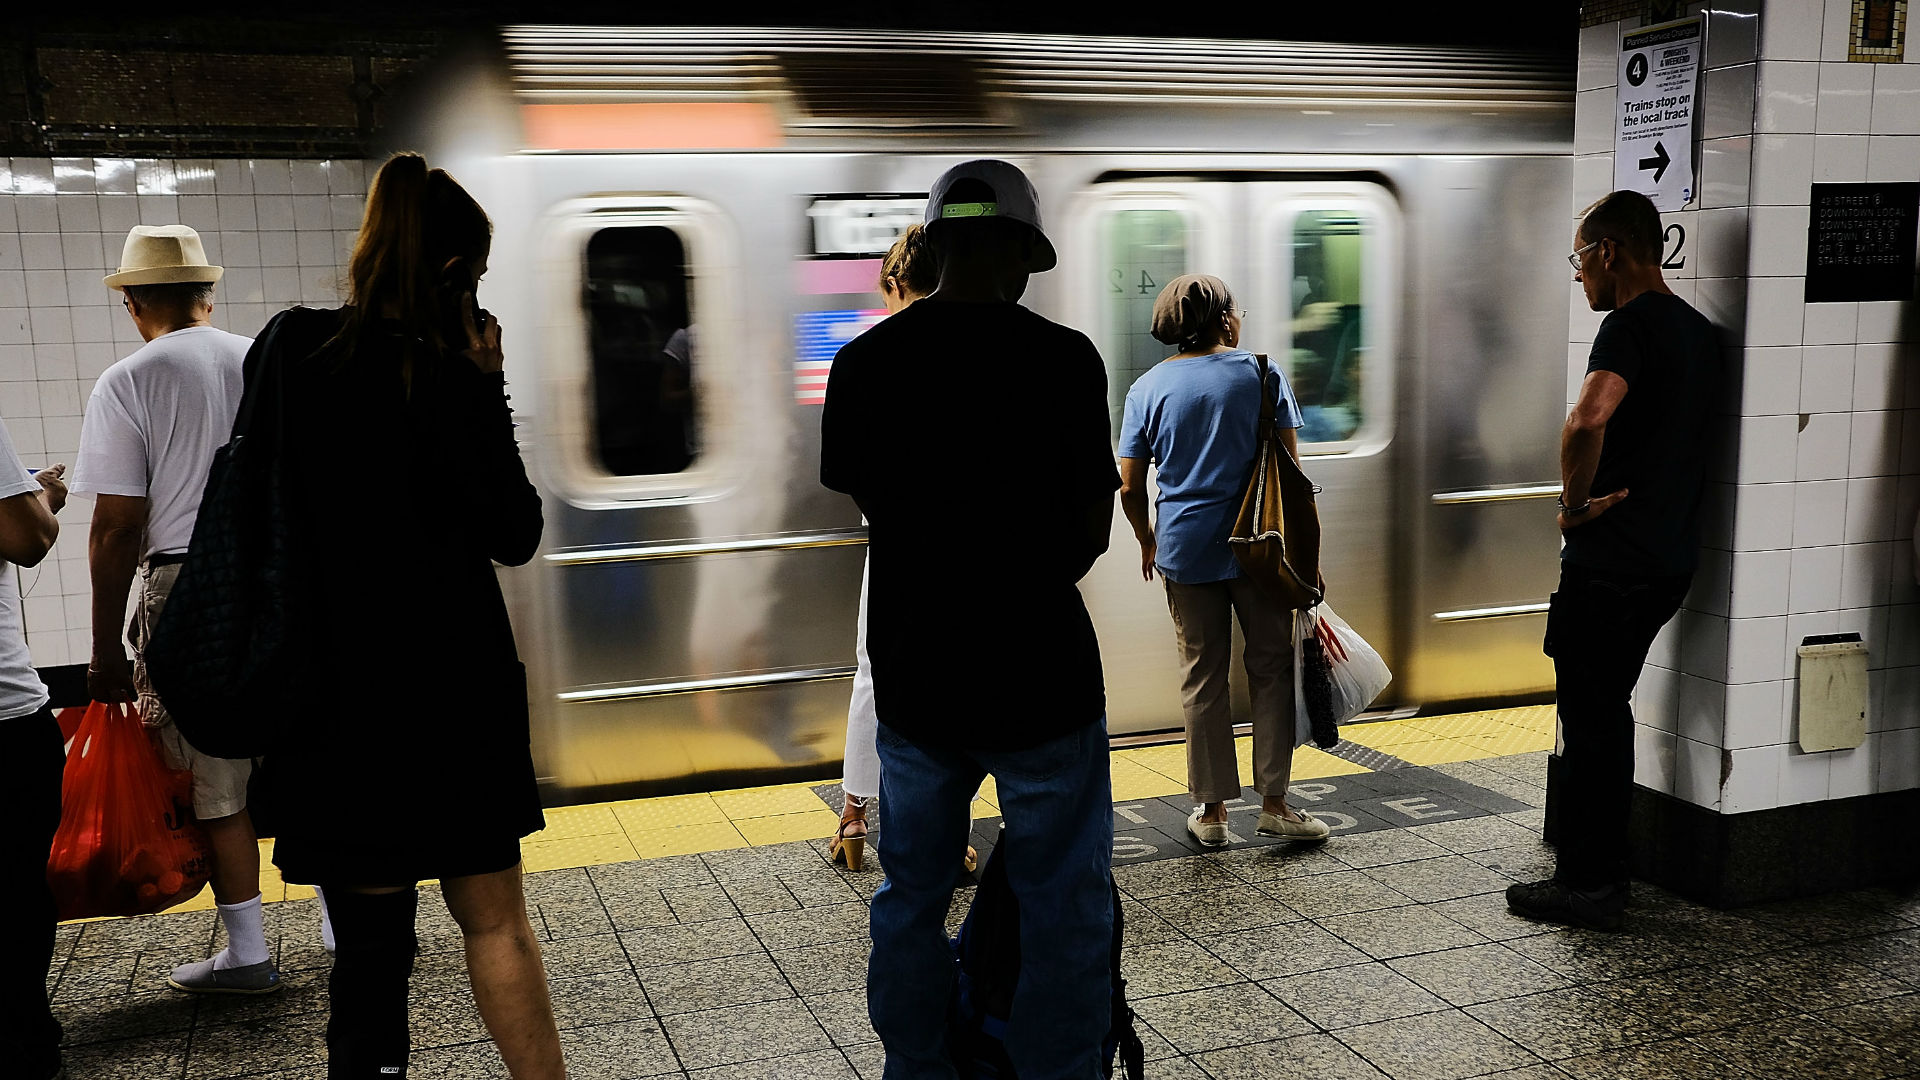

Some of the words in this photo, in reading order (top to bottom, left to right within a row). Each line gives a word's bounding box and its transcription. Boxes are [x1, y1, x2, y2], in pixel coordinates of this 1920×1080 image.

[1626, 35, 1649, 46] Planned
[1649, 32, 1670, 42] Service
[1632, 60, 1641, 78] 4
[1624, 99, 1654, 113] Trains
[1655, 96, 1676, 108] stop
[1678, 94, 1690, 104] on
[1623, 115, 1638, 127] the
[1640, 110, 1662, 124] local
[1664, 106, 1689, 120] track
[1834, 196, 1870, 206] STREET
[1820, 208, 1874, 218] DOWNTOWN
[1876, 208, 1905, 217] LOCAL
[1819, 220, 1879, 230] DOWNSTAIRS
[1819, 232, 1858, 242] UPTOWN
[1818, 244, 1832, 254] OR
[1865, 255, 1902, 265] STREET
